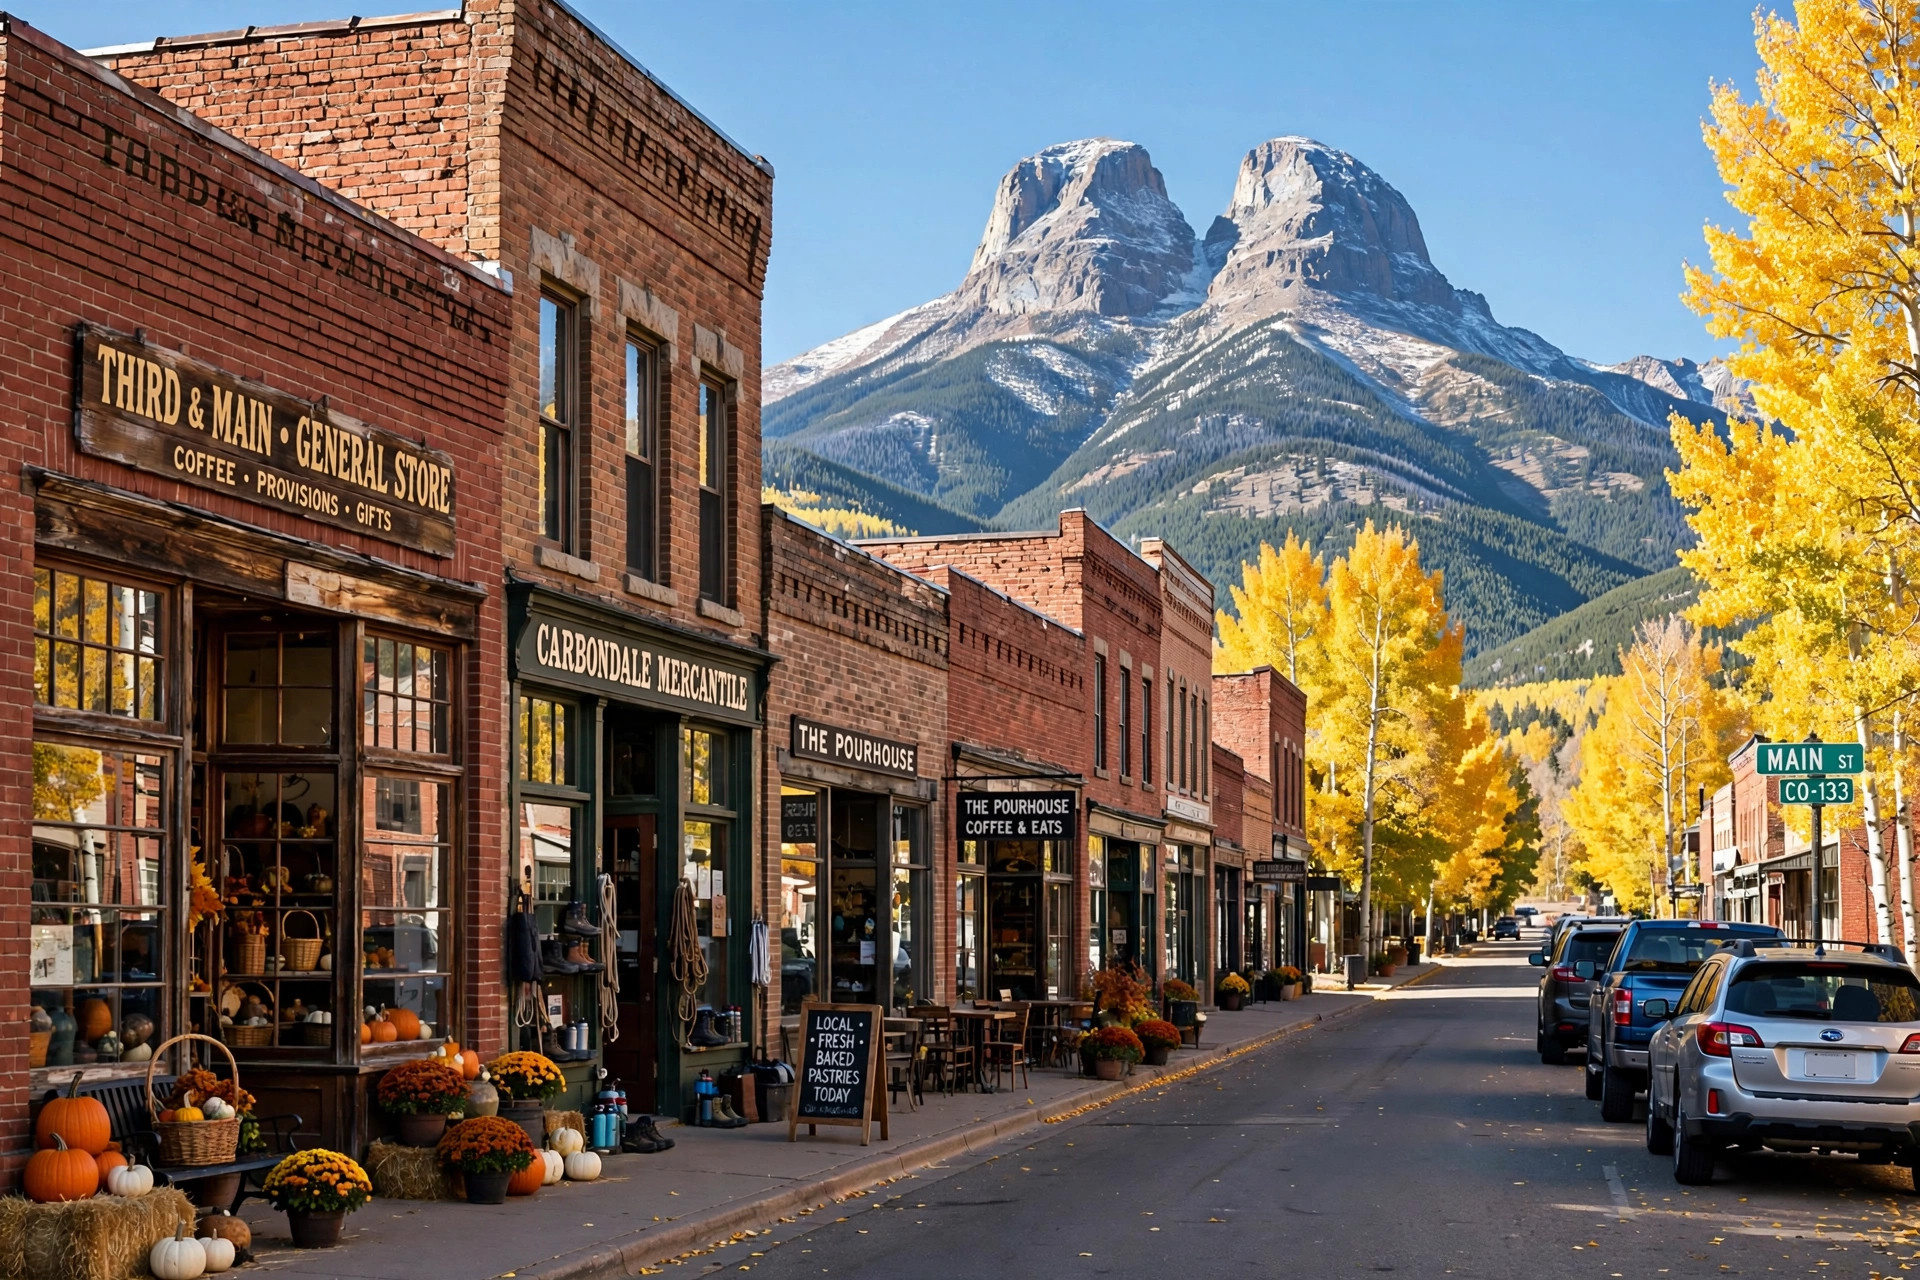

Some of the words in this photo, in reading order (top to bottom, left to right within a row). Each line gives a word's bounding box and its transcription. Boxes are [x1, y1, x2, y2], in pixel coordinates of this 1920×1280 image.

[97, 343, 181, 426] THIRD
[188, 386, 205, 430] &
[211, 384, 273, 456] MAIN
[296, 415, 389, 494] GENERAL
[394, 450, 451, 514] STORE
[174, 445, 236, 486] COFFEE
[257, 470, 339, 516] PROVISIONS
[356, 502, 392, 532] GIFTS
[536, 622, 652, 690] CARBONDALE
[657, 655, 748, 712] MERCANTILE
[798, 724, 828, 755] THE
[835, 732, 915, 772] POURHOUSE
[1767, 747, 1823, 772] MAIN
[1838, 754, 1854, 769] ST
[1785, 781, 1849, 801] CO-133
[964, 799, 989, 815] THE
[993, 799, 1070, 815] POURHOUSE
[965, 820, 1013, 835] COFFEE
[1017, 820, 1027, 835] &
[1031, 820, 1063, 835] EATS
[815, 1015, 854, 1032] LOCAL
[818, 1033, 855, 1049] FRESH
[815, 1050, 855, 1067] BAKED
[808, 1068, 860, 1085] PASTRIES
[813, 1086, 851, 1103] TODAY
